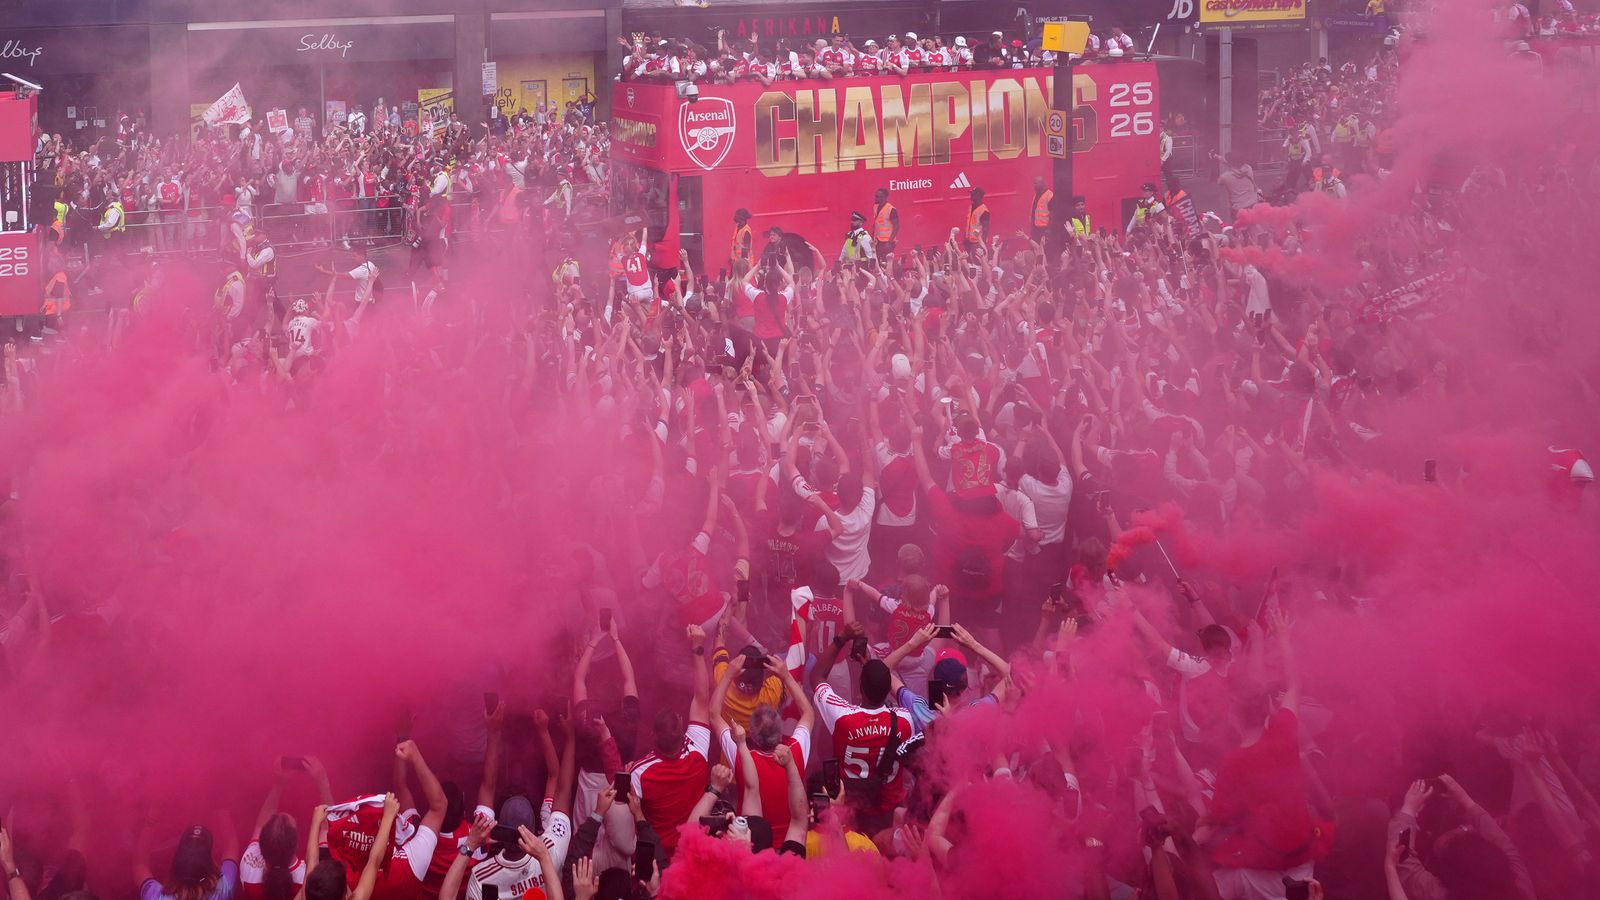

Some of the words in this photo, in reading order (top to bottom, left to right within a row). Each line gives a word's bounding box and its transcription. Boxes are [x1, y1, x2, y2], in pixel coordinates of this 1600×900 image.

[1167, 0, 1193, 20] JD
[737, 16, 841, 37] AFRIKANA
[296, 34, 353, 58] Selbys
[494, 86, 512, 98] rla
[1110, 82, 1153, 107] 25
[687, 109, 728, 123] Arsenal
[1051, 118, 1061, 128] 20
[754, 75, 1098, 177] CHAMPIONS
[1110, 112, 1154, 137] 26
[889, 178, 933, 191] Emirates
[0, 246, 28, 260] 25
[0, 263, 29, 276] 26
[627, 257, 642, 273] 41
[290, 328, 306, 344] 14
